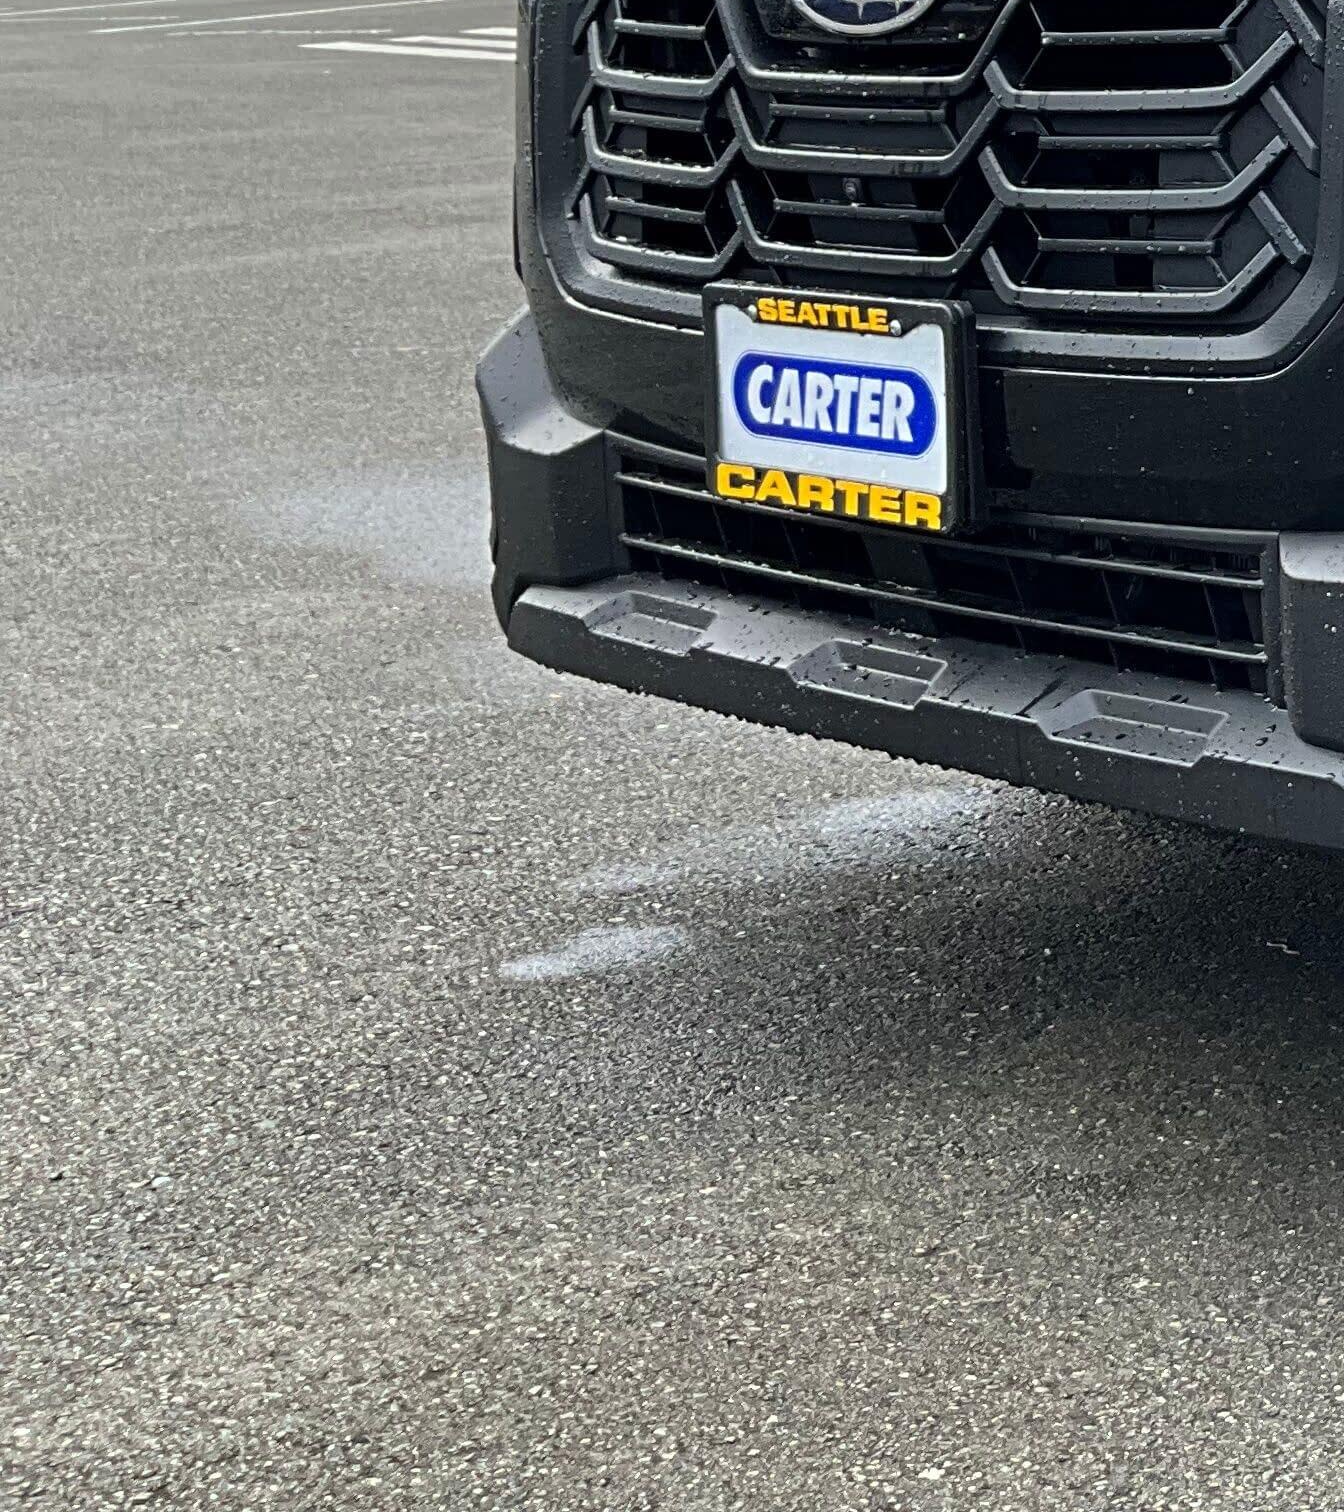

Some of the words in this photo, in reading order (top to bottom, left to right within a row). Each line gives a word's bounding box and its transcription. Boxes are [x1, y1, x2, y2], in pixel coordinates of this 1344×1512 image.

[756, 297, 890, 333] SEATTLE
[748, 365, 915, 443] CARTER
[717, 463, 942, 530] CARTER
